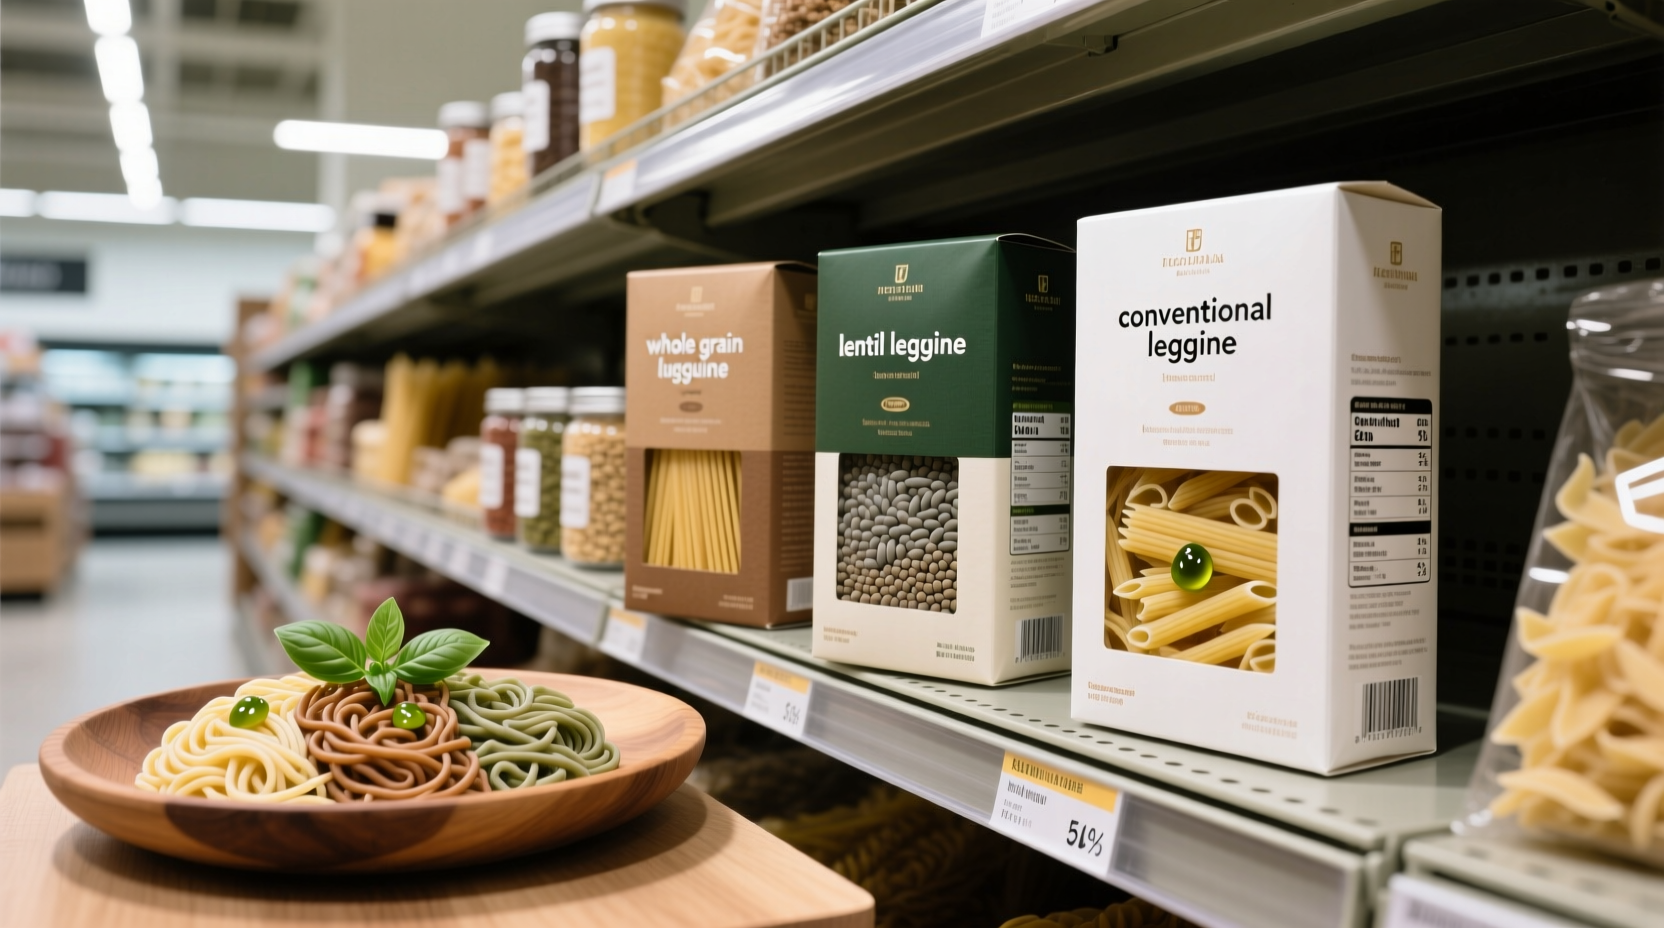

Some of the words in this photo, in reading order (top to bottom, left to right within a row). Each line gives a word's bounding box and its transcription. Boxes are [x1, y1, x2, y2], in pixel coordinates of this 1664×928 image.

[1118, 292, 1272, 328] conventional
[646, 331, 696, 355] whole
[699, 331, 744, 361] grain
[838, 331, 885, 357] lentil
[890, 331, 967, 362] leggine
[1148, 330, 1237, 364] leggine
